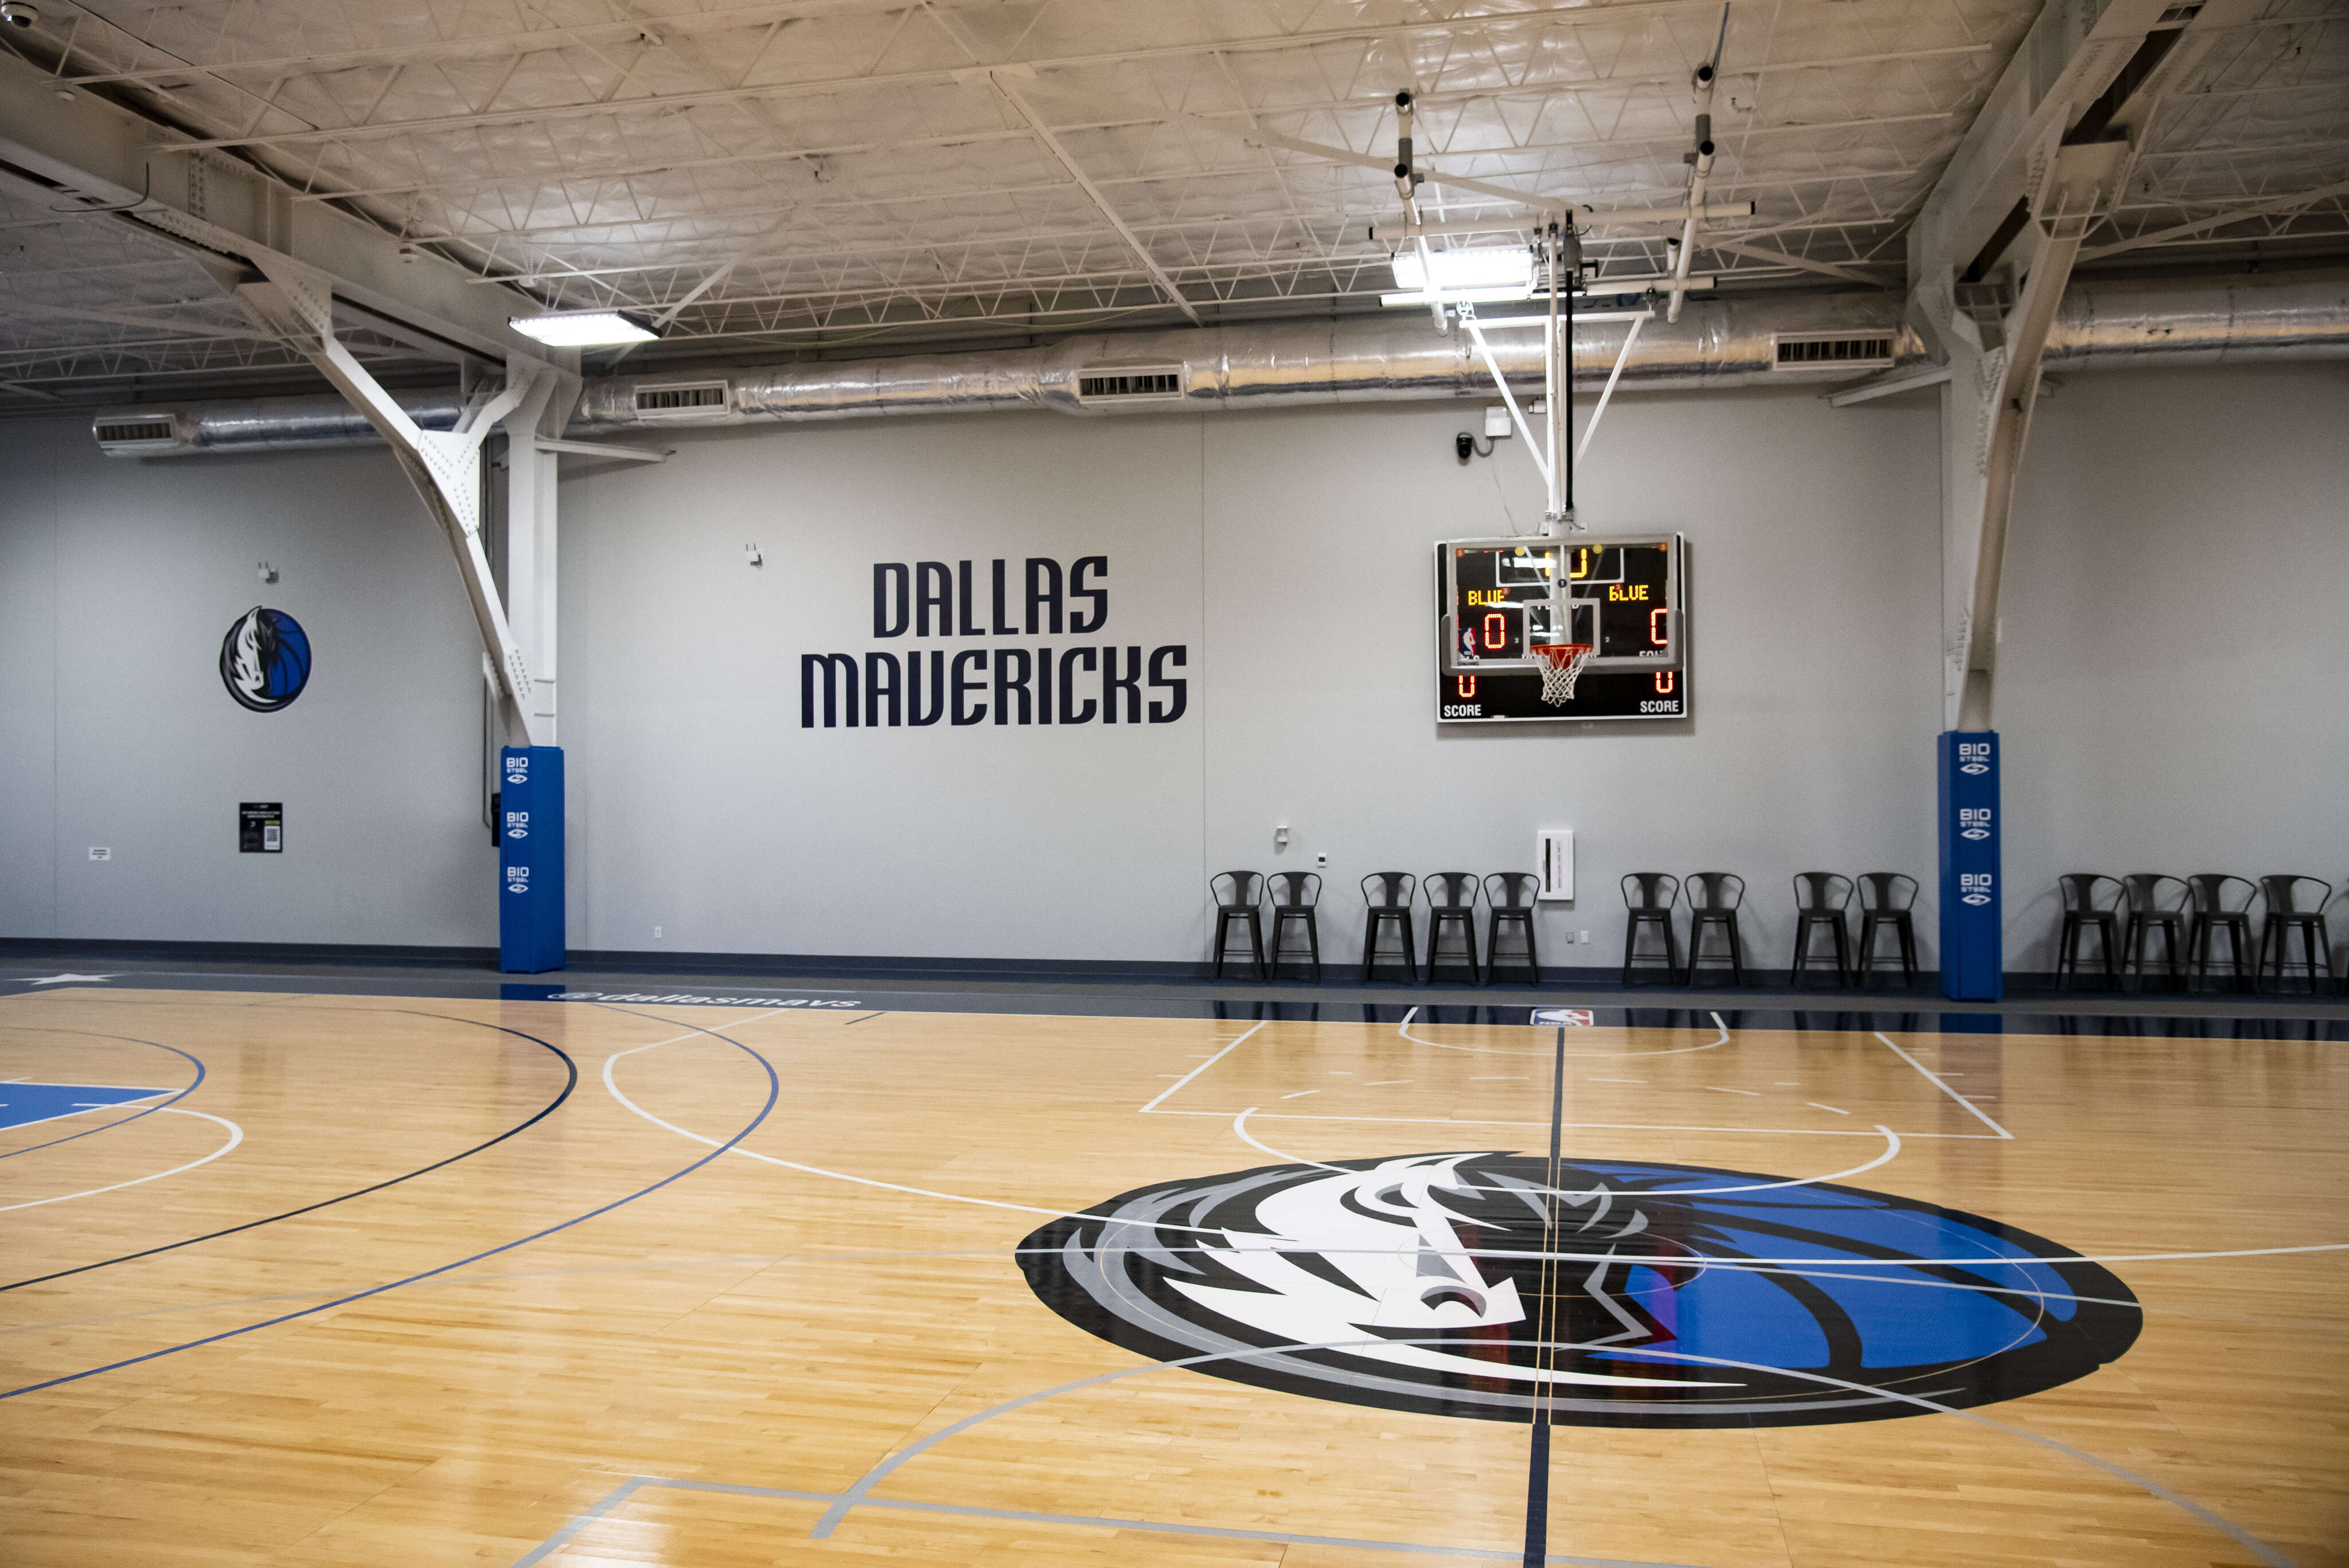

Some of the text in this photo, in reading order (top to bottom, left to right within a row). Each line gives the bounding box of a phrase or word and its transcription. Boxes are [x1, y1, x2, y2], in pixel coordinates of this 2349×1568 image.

[873, 556, 1107, 638] DALLAS
[1468, 589, 1507, 605] BLUE
[1609, 584, 1649, 601] BLUE
[1484, 613, 1505, 649] 0
[801, 645, 1187, 729] MAVERICKS
[1444, 704, 1481, 717] SCORE
[1640, 700, 1679, 713] SCORE
[1958, 743, 1991, 755] BIO
[506, 757, 529, 768] BIO
[506, 812, 529, 822] BIO
[1960, 808, 1991, 820] BIO
[507, 866, 529, 877] BIO
[1960, 874, 1992, 886] BIO
